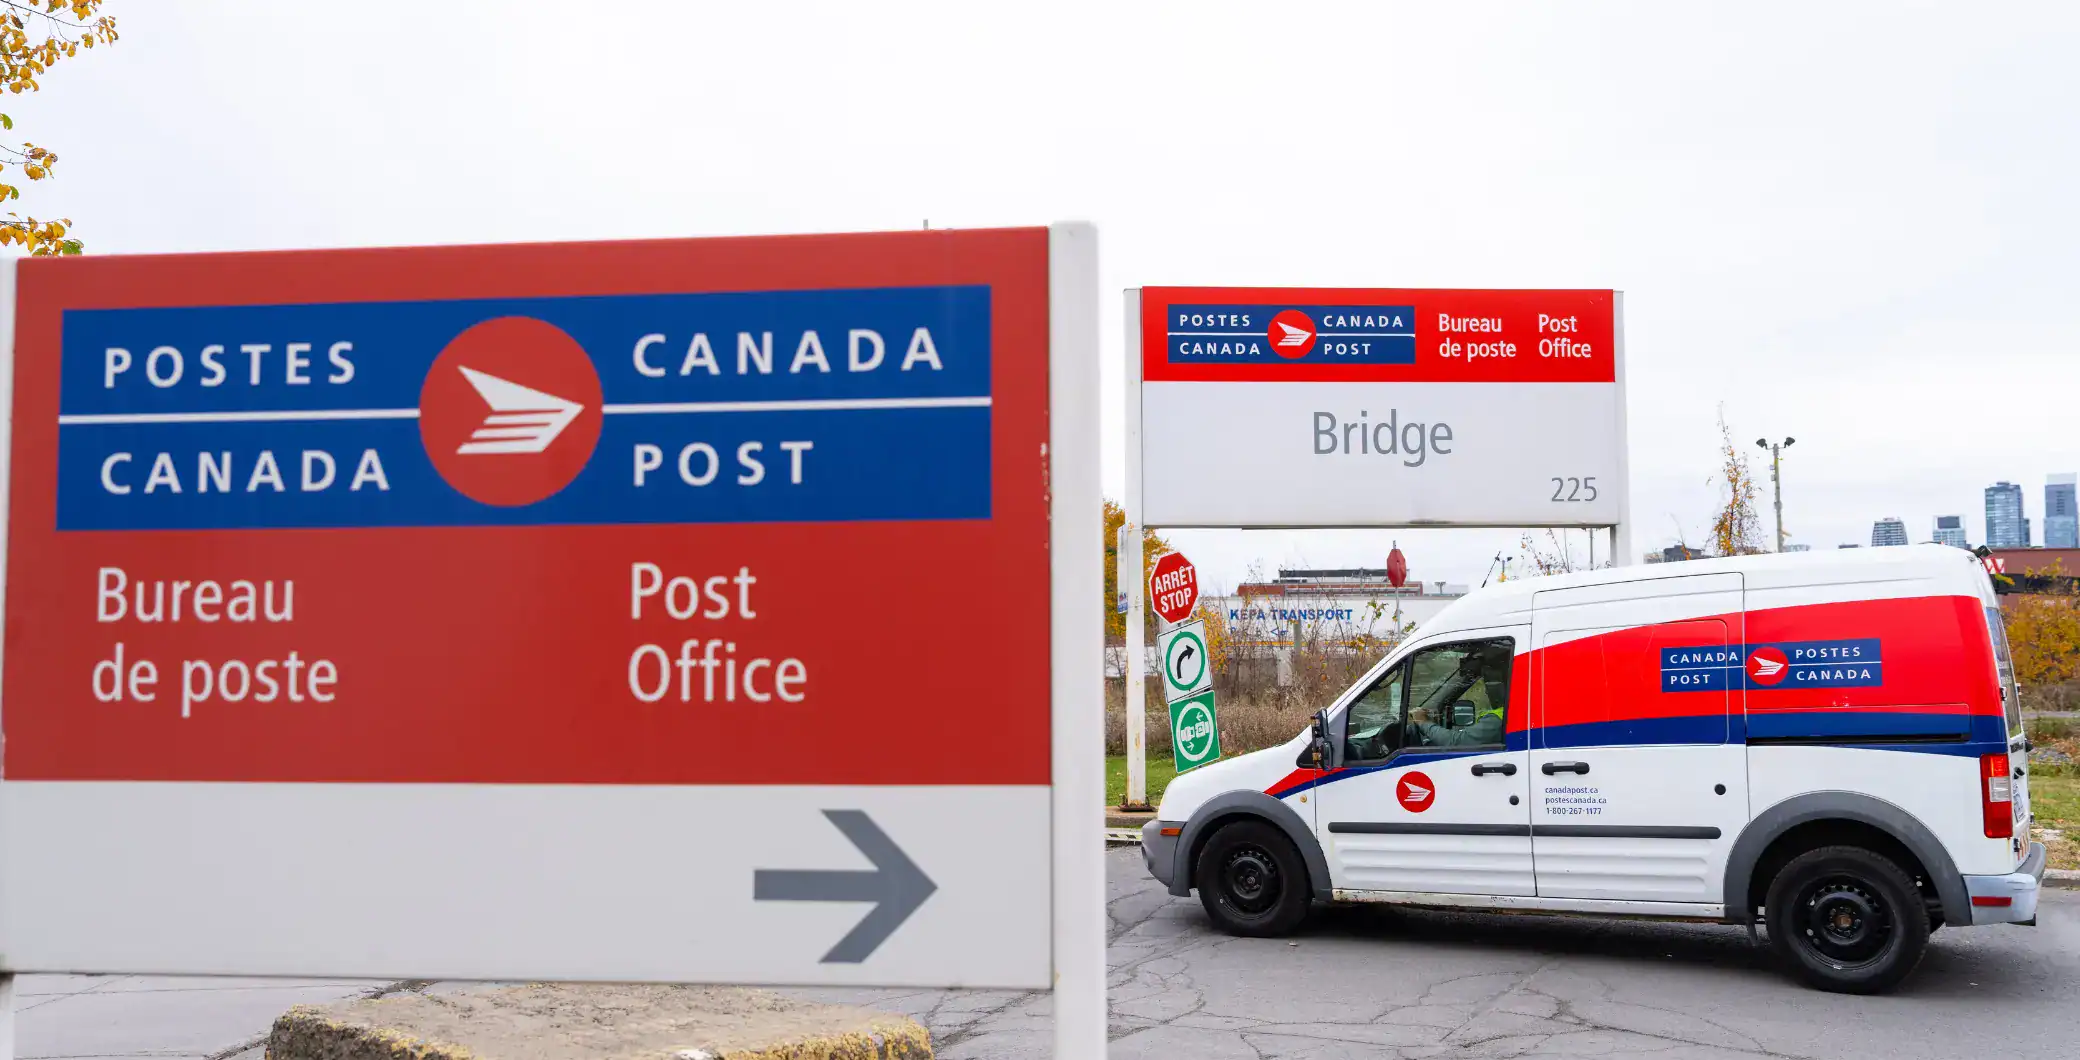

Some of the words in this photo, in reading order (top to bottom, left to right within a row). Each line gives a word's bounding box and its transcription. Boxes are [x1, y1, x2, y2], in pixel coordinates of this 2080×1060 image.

[1179, 314, 1250, 327] POSTES
[1323, 315, 1403, 328] CANADA
[1439, 313, 1502, 333] Bureau
[1538, 313, 1578, 333] Post
[632, 326, 944, 378] CANADA
[1179, 342, 1261, 355] CANADA
[1324, 343, 1371, 355] POST
[1439, 337, 1461, 358] de
[1467, 340, 1517, 363] poste
[1538, 337, 1592, 358] Office
[104, 341, 356, 389] POSTES
[1312, 408, 1453, 468] Bridge
[100, 448, 390, 495] CANADA
[633, 440, 814, 487] POST
[1550, 476, 1598, 503] 225
[1154, 565, 1195, 595] ARRÊT
[96, 566, 295, 623] Bureau
[630, 561, 758, 620] Post
[1160, 587, 1193, 614] STOP
[1270, 609, 1353, 620] TRANSPORT
[1670, 651, 1739, 664] CANADA
[1795, 646, 1861, 659] POSTES
[91, 641, 159, 703] de
[181, 650, 338, 719] poste
[628, 638, 808, 703] Office
[1670, 674, 1711, 685] POST
[1796, 669, 1872, 681] CANADA
[1545, 786, 1599, 795] canadapost.ca
[1545, 796, 1607, 805] postescanada.ca
[1546, 807, 1602, 815] 1-800-267-1177
